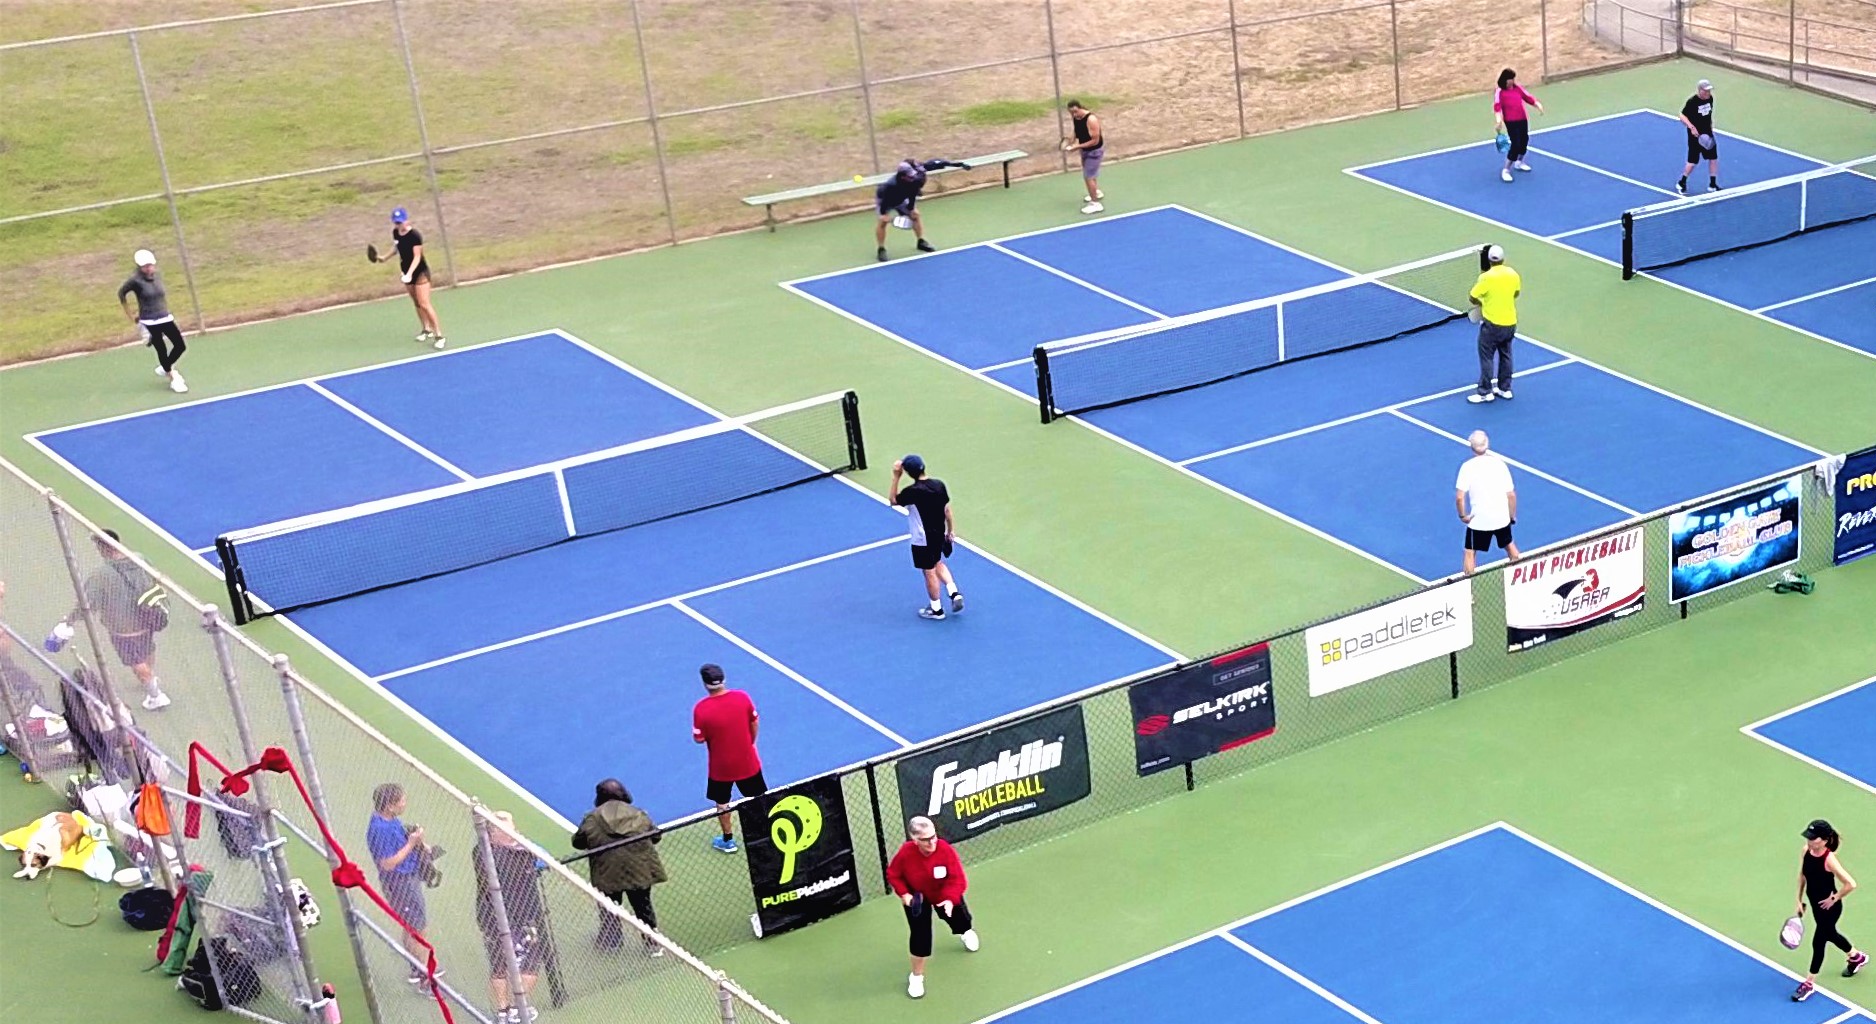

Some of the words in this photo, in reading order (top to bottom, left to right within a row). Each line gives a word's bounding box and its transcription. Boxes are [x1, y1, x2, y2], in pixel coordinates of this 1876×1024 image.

[1511, 559, 1547, 585] PLAY
[1345, 602, 1456, 660] paddletek
[1173, 681, 1267, 724] SELKIRK
[1216, 697, 1268, 720] SPORT
[954, 775, 1045, 819] PICKLEBALL
